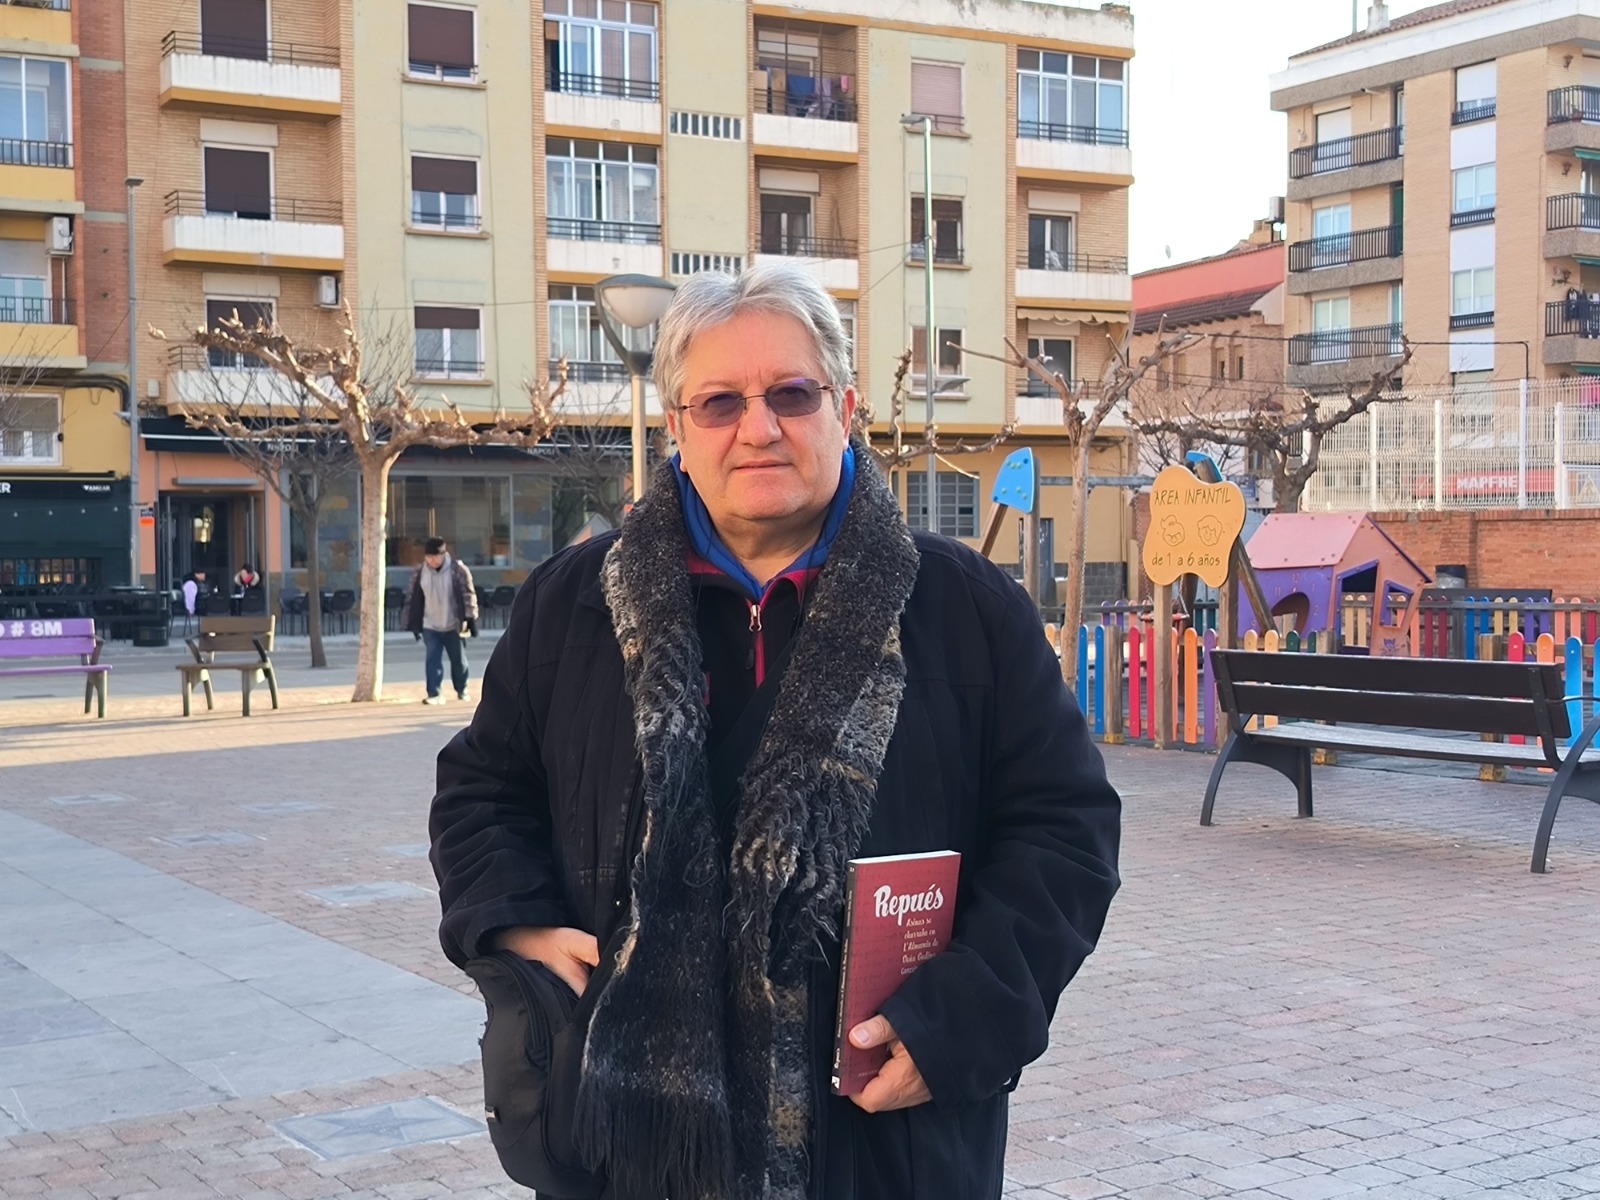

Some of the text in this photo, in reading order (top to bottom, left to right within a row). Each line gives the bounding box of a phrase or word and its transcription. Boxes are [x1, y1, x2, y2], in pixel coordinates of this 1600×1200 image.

[267, 443, 299, 452] NAPOI
[0, 481, 11, 493] R
[1457, 475, 1517, 489] MAPFRE
[1184, 487, 1231, 505] INFANTIL
[1151, 551, 1220, 567] de 1 a 6 años
[30, 620, 63, 637] 8M
[873, 883, 944, 928] Repués
